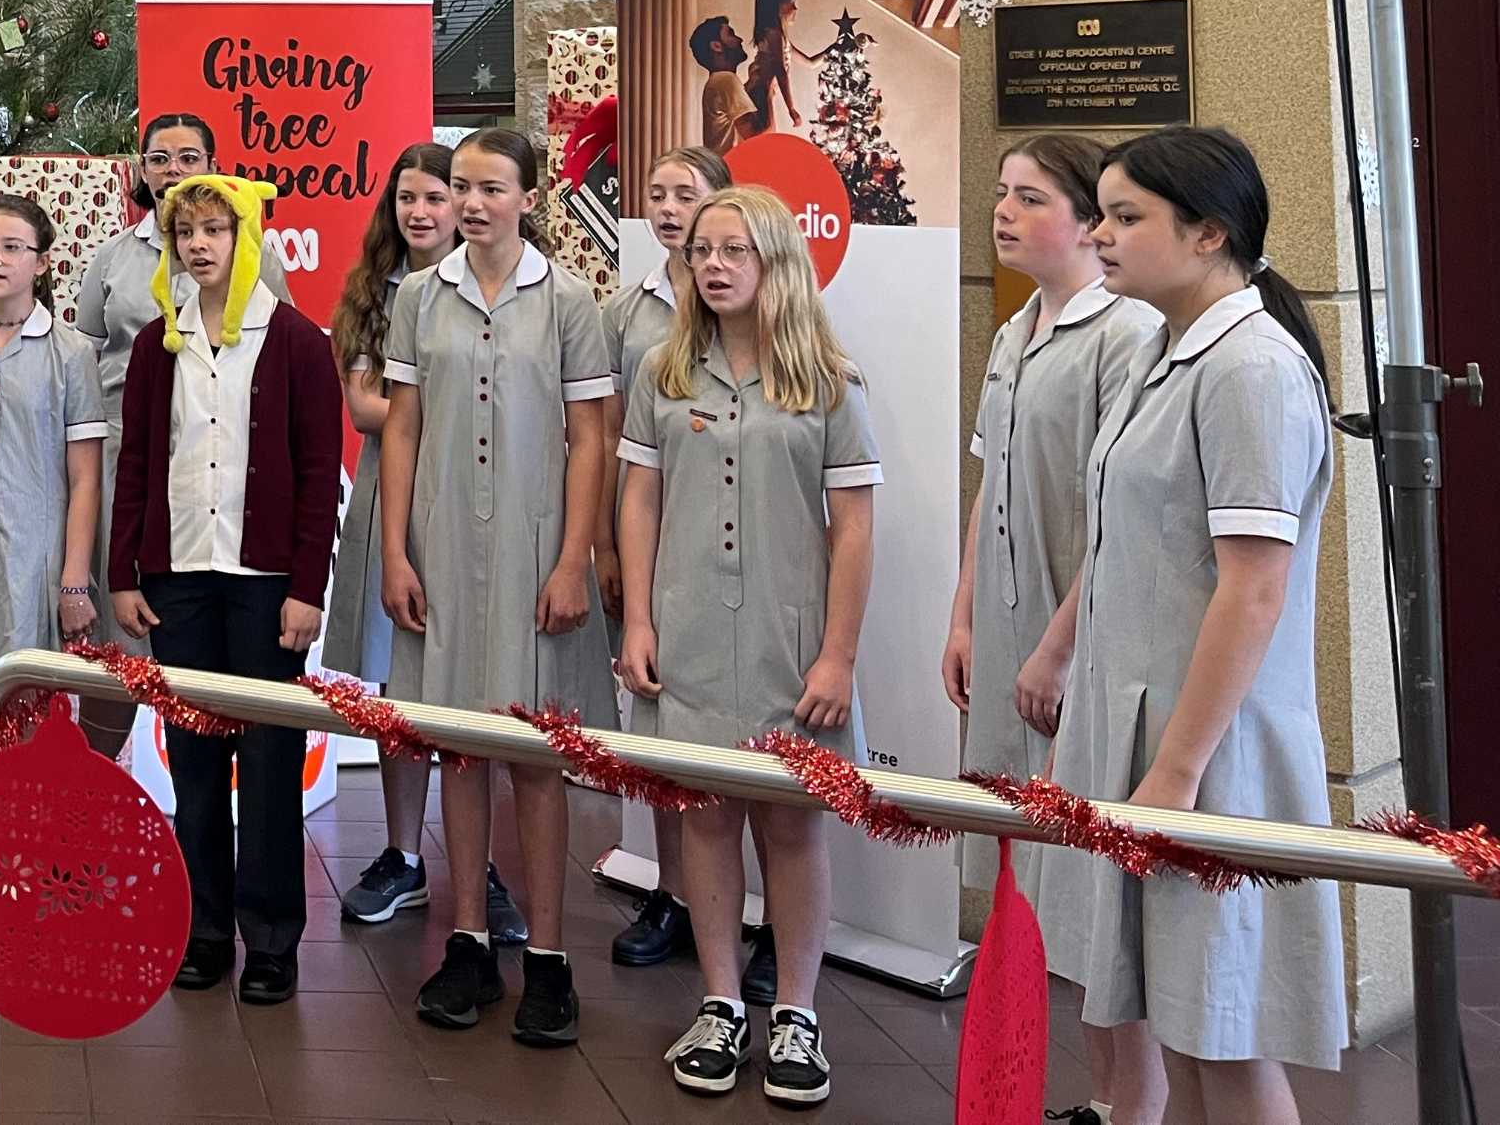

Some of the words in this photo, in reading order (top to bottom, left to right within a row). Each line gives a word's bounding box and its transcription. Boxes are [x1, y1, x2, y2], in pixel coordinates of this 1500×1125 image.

[1038, 62, 1087, 72] OFFICIALLY
[1089, 61, 1127, 70] OPENED
[1130, 60, 1142, 69] BY
[1045, 49, 1064, 58] ABC
[1066, 47, 1134, 58] BROADCASTING
[1137, 45, 1177, 55] CENTRE
[202, 36, 376, 111] Giving
[1045, 85, 1063, 93] THE
[1066, 85, 1086, 93] HON
[1088, 84, 1125, 92] GARETH
[233, 92, 336, 154] tree
[217, 139, 378, 219] peal
[795, 202, 840, 240] dio
